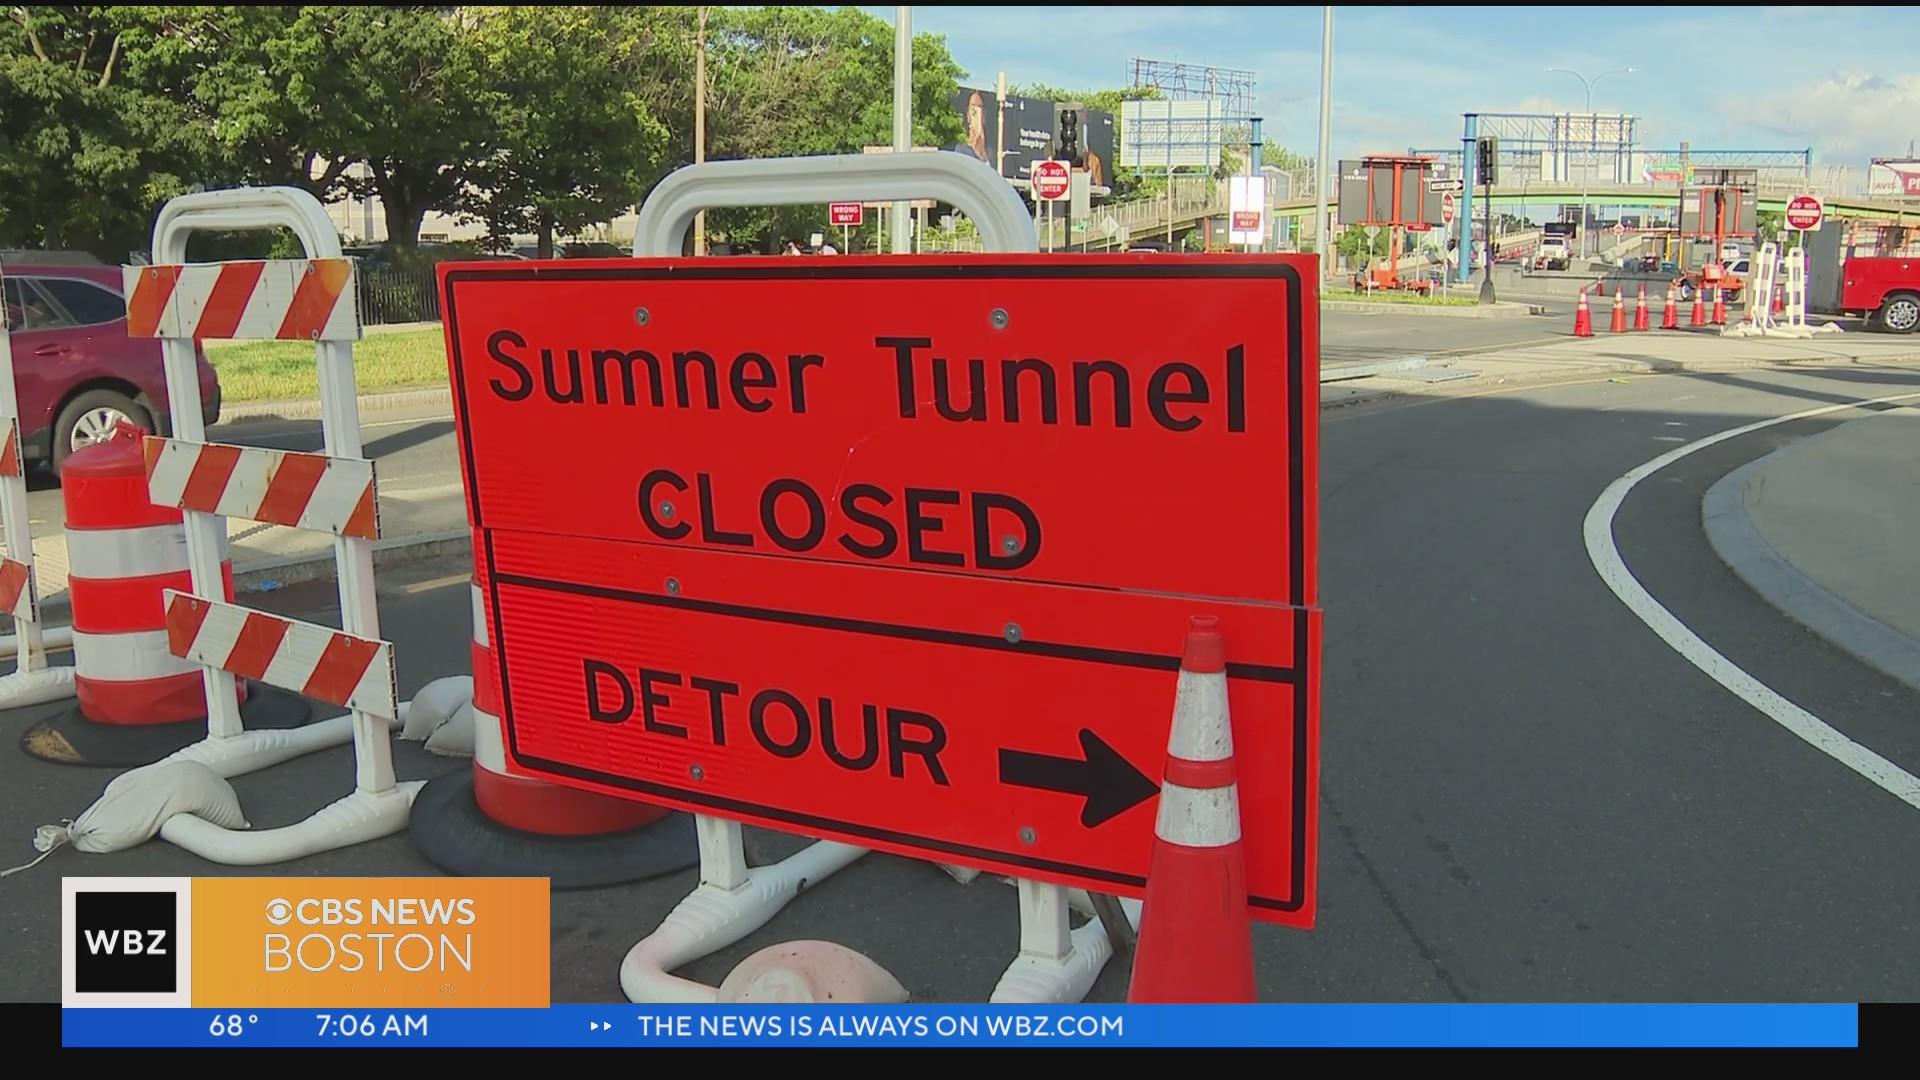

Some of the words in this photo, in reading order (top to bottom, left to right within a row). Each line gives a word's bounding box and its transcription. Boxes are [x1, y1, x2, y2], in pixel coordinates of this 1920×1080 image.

[1050, 168, 1064, 176] NOT
[833, 206, 859, 214] WRONG
[838, 214, 854, 222] WAY
[486, 329, 825, 415] Sumner
[875, 336, 1247, 434] Tunnel
[637, 469, 1043, 571] CLOSED
[584, 660, 951, 788] DETOUR
